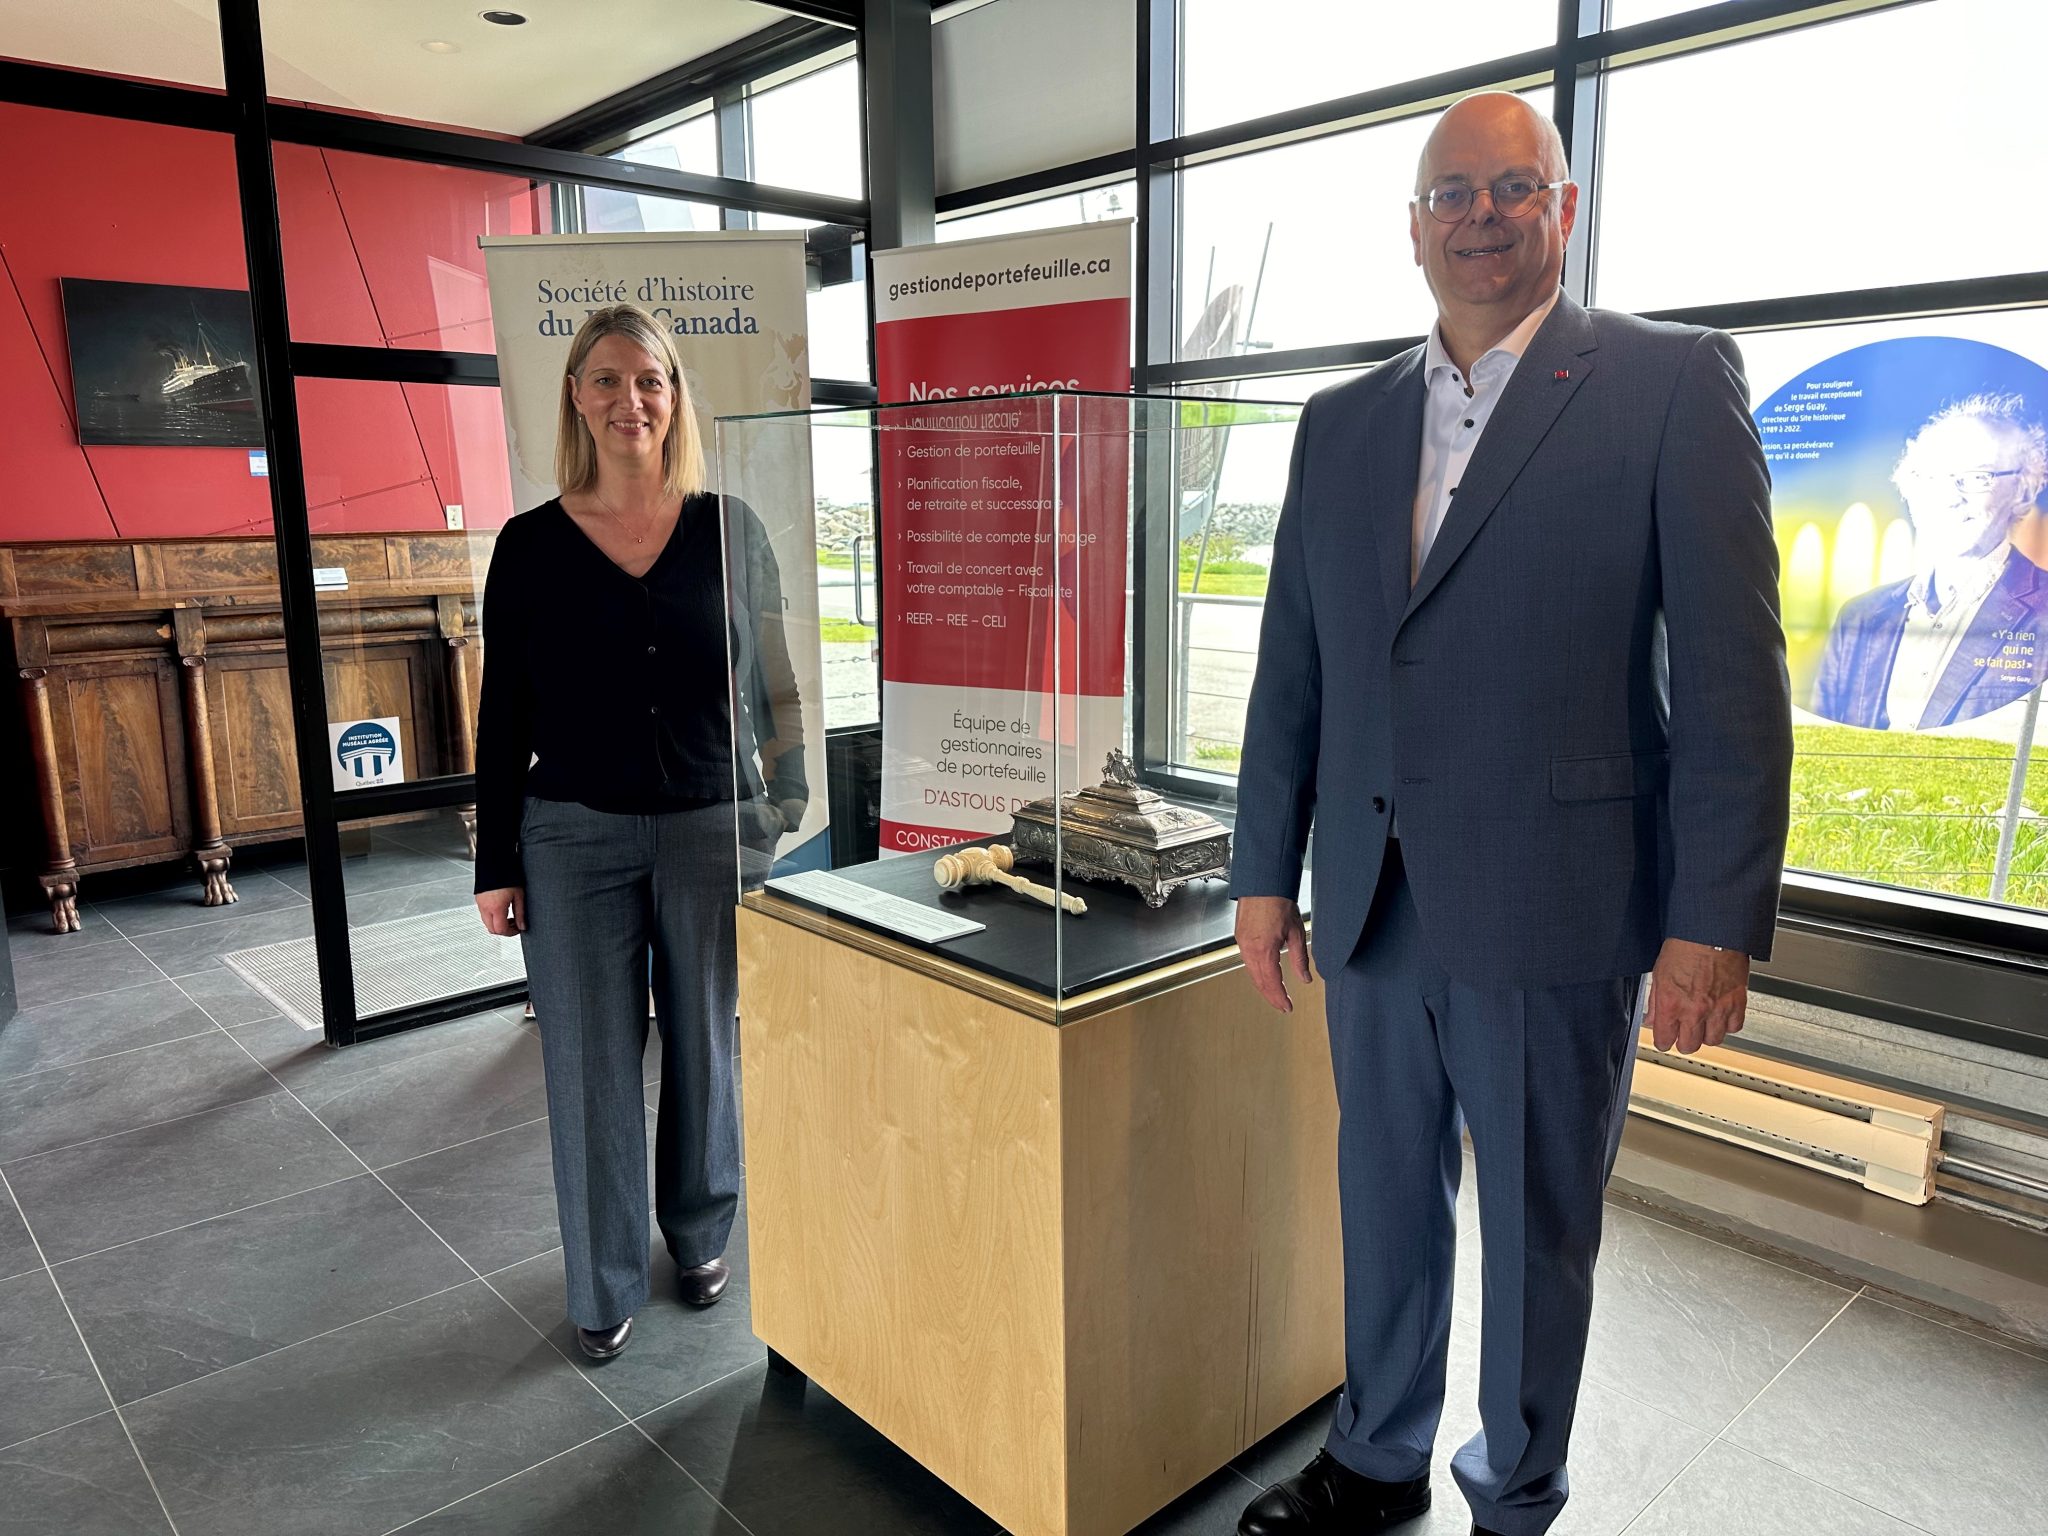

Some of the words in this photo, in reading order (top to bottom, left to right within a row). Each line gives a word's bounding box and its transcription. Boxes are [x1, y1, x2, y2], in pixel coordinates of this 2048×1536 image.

[889, 257, 1111, 300] gestiondeportefeuille.ca
[538, 279, 628, 304] Société
[637, 276, 755, 302] d’histoire
[538, 310, 575, 336] du
[909, 381, 958, 401] Nos
[1783, 403, 1805, 413] Serge
[1761, 416, 1789, 424] directeur
[1790, 415, 1798, 423] du
[1799, 414, 1812, 422] Site
[1812, 413, 1846, 422] historique
[1762, 425, 1778, 433] 1989
[907, 445, 951, 458] Gestion
[955, 444, 971, 457] de
[974, 442, 1041, 459] portefeuille
[1791, 441, 1834, 450] persévérance
[1795, 451, 1820, 459] donnée
[907, 477, 979, 490] Planification
[982, 476, 1023, 491] fiscale,
[907, 499, 922, 510] de
[925, 498, 968, 510] retraite
[971, 499, 984, 510] et
[987, 499, 1063, 510] successorae
[907, 530, 963, 543] Possibilité
[966, 531, 983, 543] de
[986, 532, 1031, 546] compte
[1034, 532, 1051, 544] sur
[1057, 532, 1097, 547] mage
[907, 561, 943, 575] Travail
[946, 562, 962, 575] de
[966, 563, 1011, 576] concert
[1015, 565, 1044, 577] avec
[907, 583, 935, 595] votre
[938, 583, 1004, 598] comptable
[1019, 584, 1073, 598] Fiscalite
[906, 612, 933, 625] REER
[947, 613, 968, 626] REE
[982, 614, 1007, 628] CELI
[2015, 630, 2035, 640] rien
[2002, 644, 2019, 656] qui
[2020, 646, 2034, 656] ne
[1973, 657, 1985, 667] se
[1986, 656, 2003, 668] fait
[953, 709, 1006, 734] Équipe
[1010, 718, 1031, 734] de
[940, 738, 1042, 760] gestionnaires
[936, 758, 957, 773] de
[962, 763, 1046, 783] portefeuille
[924, 788, 1006, 812] D’ASTOUS
